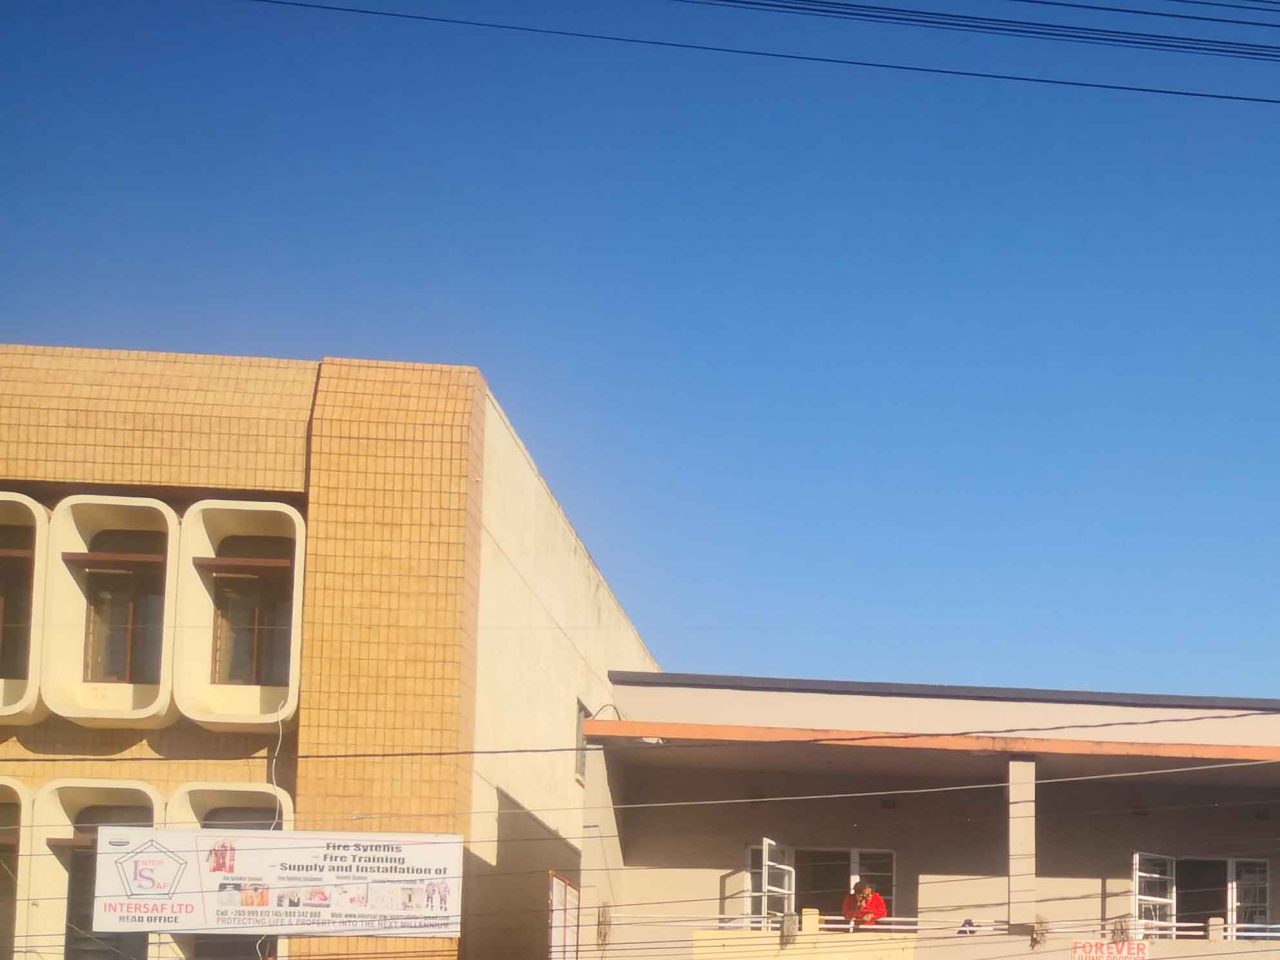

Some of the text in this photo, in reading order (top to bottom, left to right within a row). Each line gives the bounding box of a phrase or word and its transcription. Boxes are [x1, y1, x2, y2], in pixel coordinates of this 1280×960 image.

[326, 842, 350, 851] Fire
[323, 854, 406, 865] Fire Training
[280, 862, 447, 875] Supply and Installation of
[104, 902, 194, 914] INTERSAF LTD
[119, 915, 144, 923] HEAD
[216, 917, 266, 925] PROTECTING
[1072, 941, 1146, 955] FOREVER
